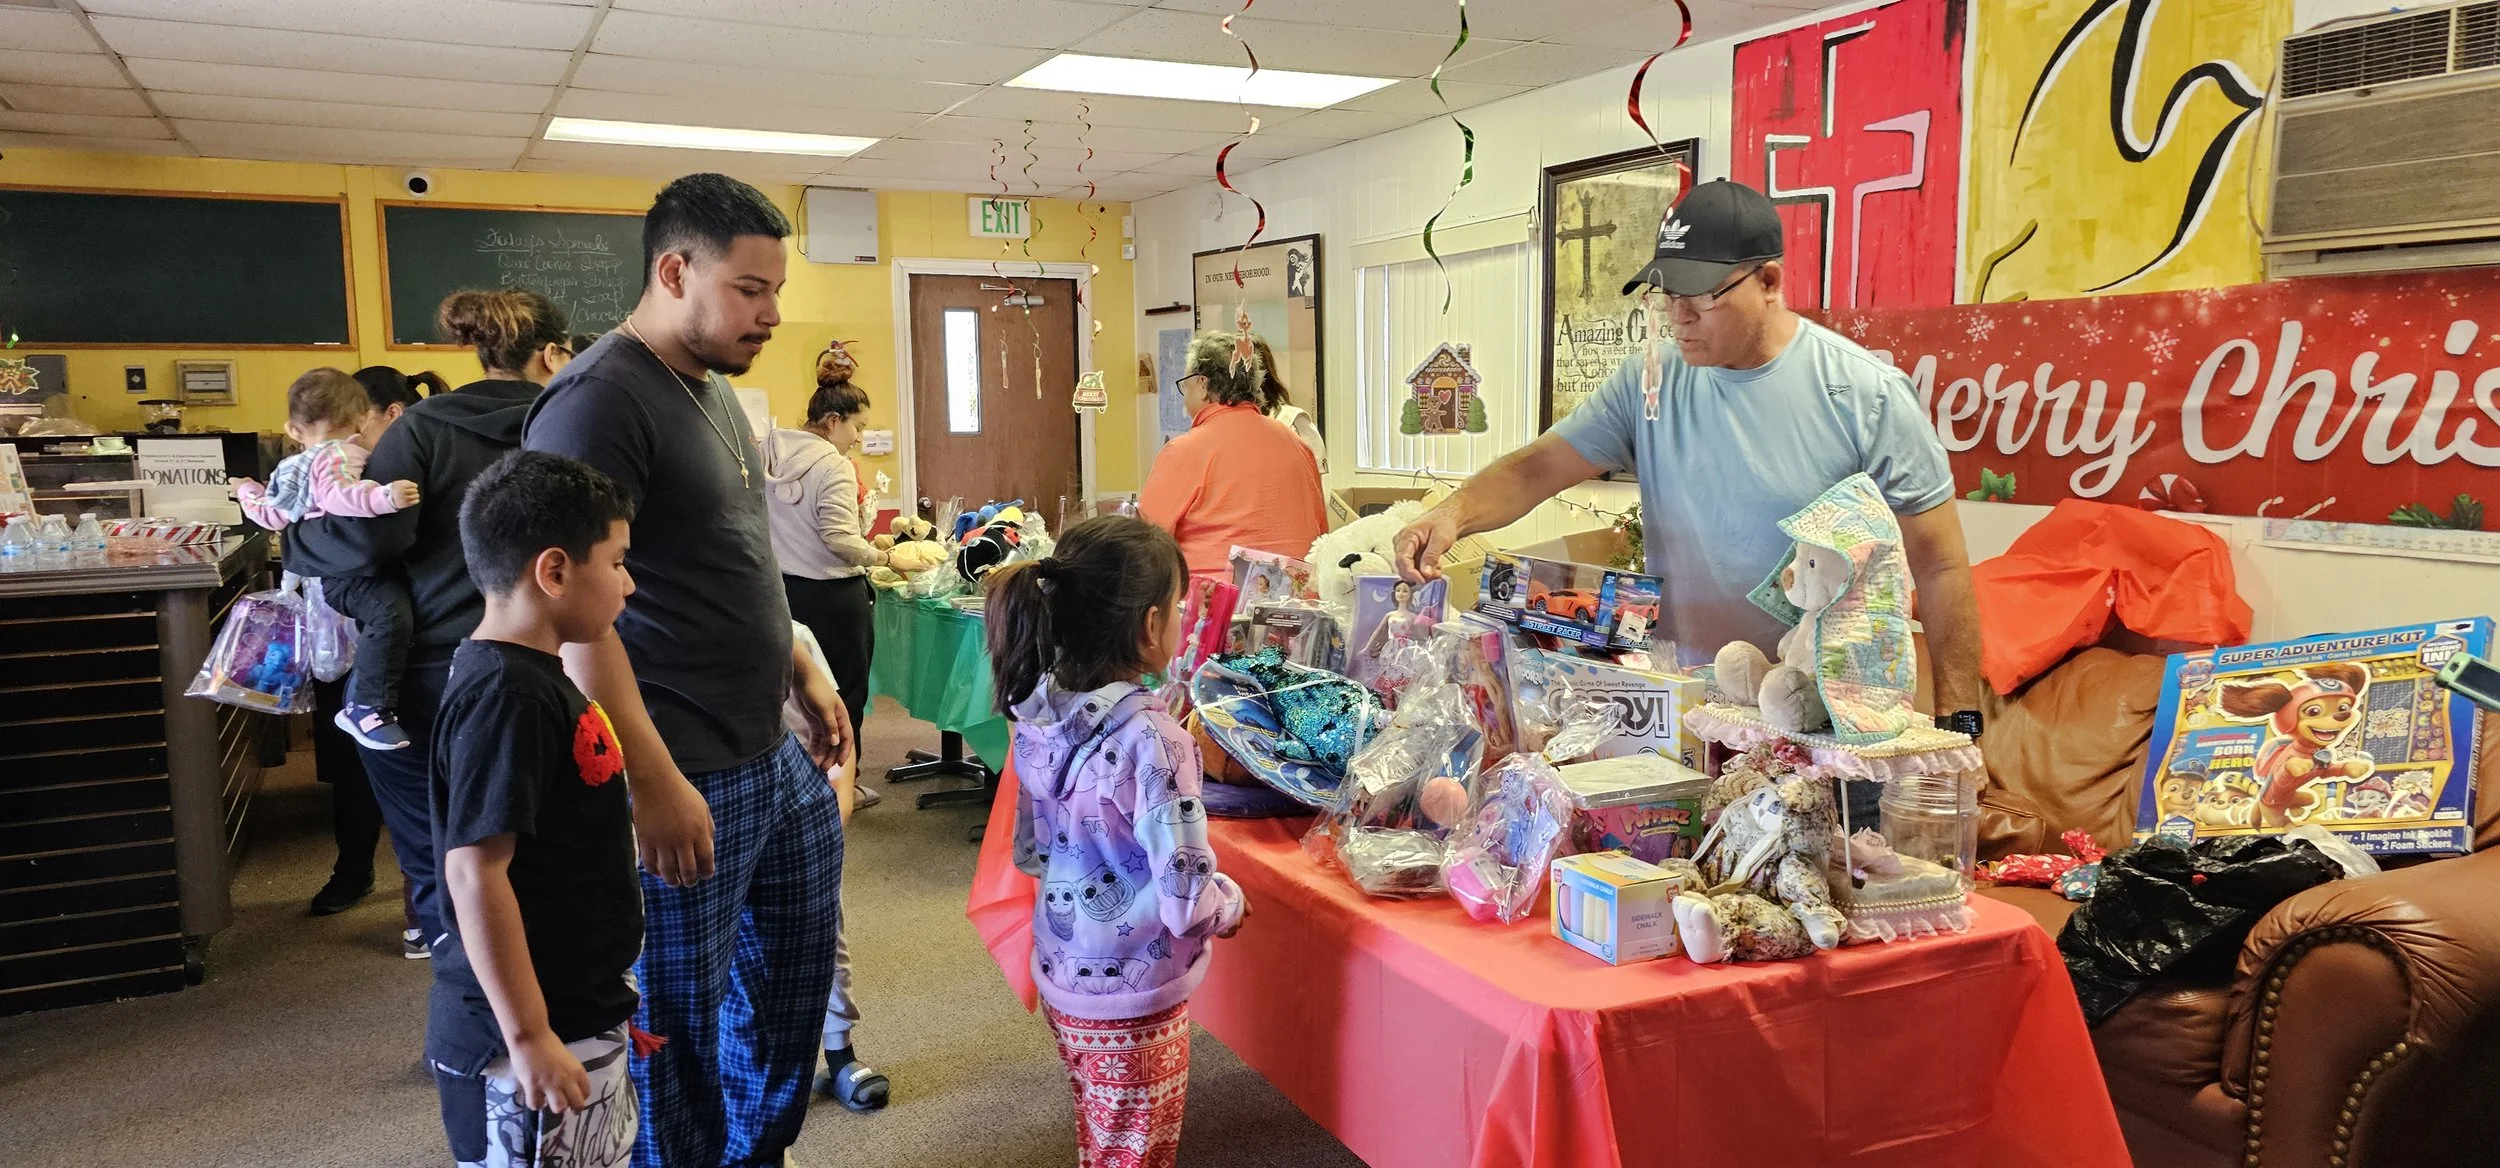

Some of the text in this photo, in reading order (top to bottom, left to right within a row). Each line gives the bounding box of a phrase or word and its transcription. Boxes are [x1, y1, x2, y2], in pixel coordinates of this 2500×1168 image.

[982, 200, 1021, 234] EXIT
[1205, 274, 1211, 283] IN
[1212, 273, 1224, 282] OUR
[1556, 308, 1675, 346] Amazing Gce
[1602, 346, 1627, 355] sweet
[1629, 344, 1643, 354] the
[1557, 358, 1573, 367] that
[1557, 378, 1577, 392] but
[142, 468, 228, 486] DONATIONS
[1529, 619, 1557, 632] STREET
[1557, 626, 1582, 640] RACER
[2219, 630, 2424, 665] SUPER ADVENTURE KIT
[1604, 680, 1621, 688] Sweet
[1622, 681, 1646, 690] Revenge
[2213, 745, 2255, 756] BORN
[2367, 831, 2401, 841] Imagine
[2402, 830, 2417, 840] Ink
[2417, 829, 2452, 839] Booklet
[2390, 841, 2415, 850] Foam
[2416, 839, 2453, 849] Stickers
[1631, 911, 1663, 922] SIDEWALK
[1636, 920, 1658, 930] CHALK
